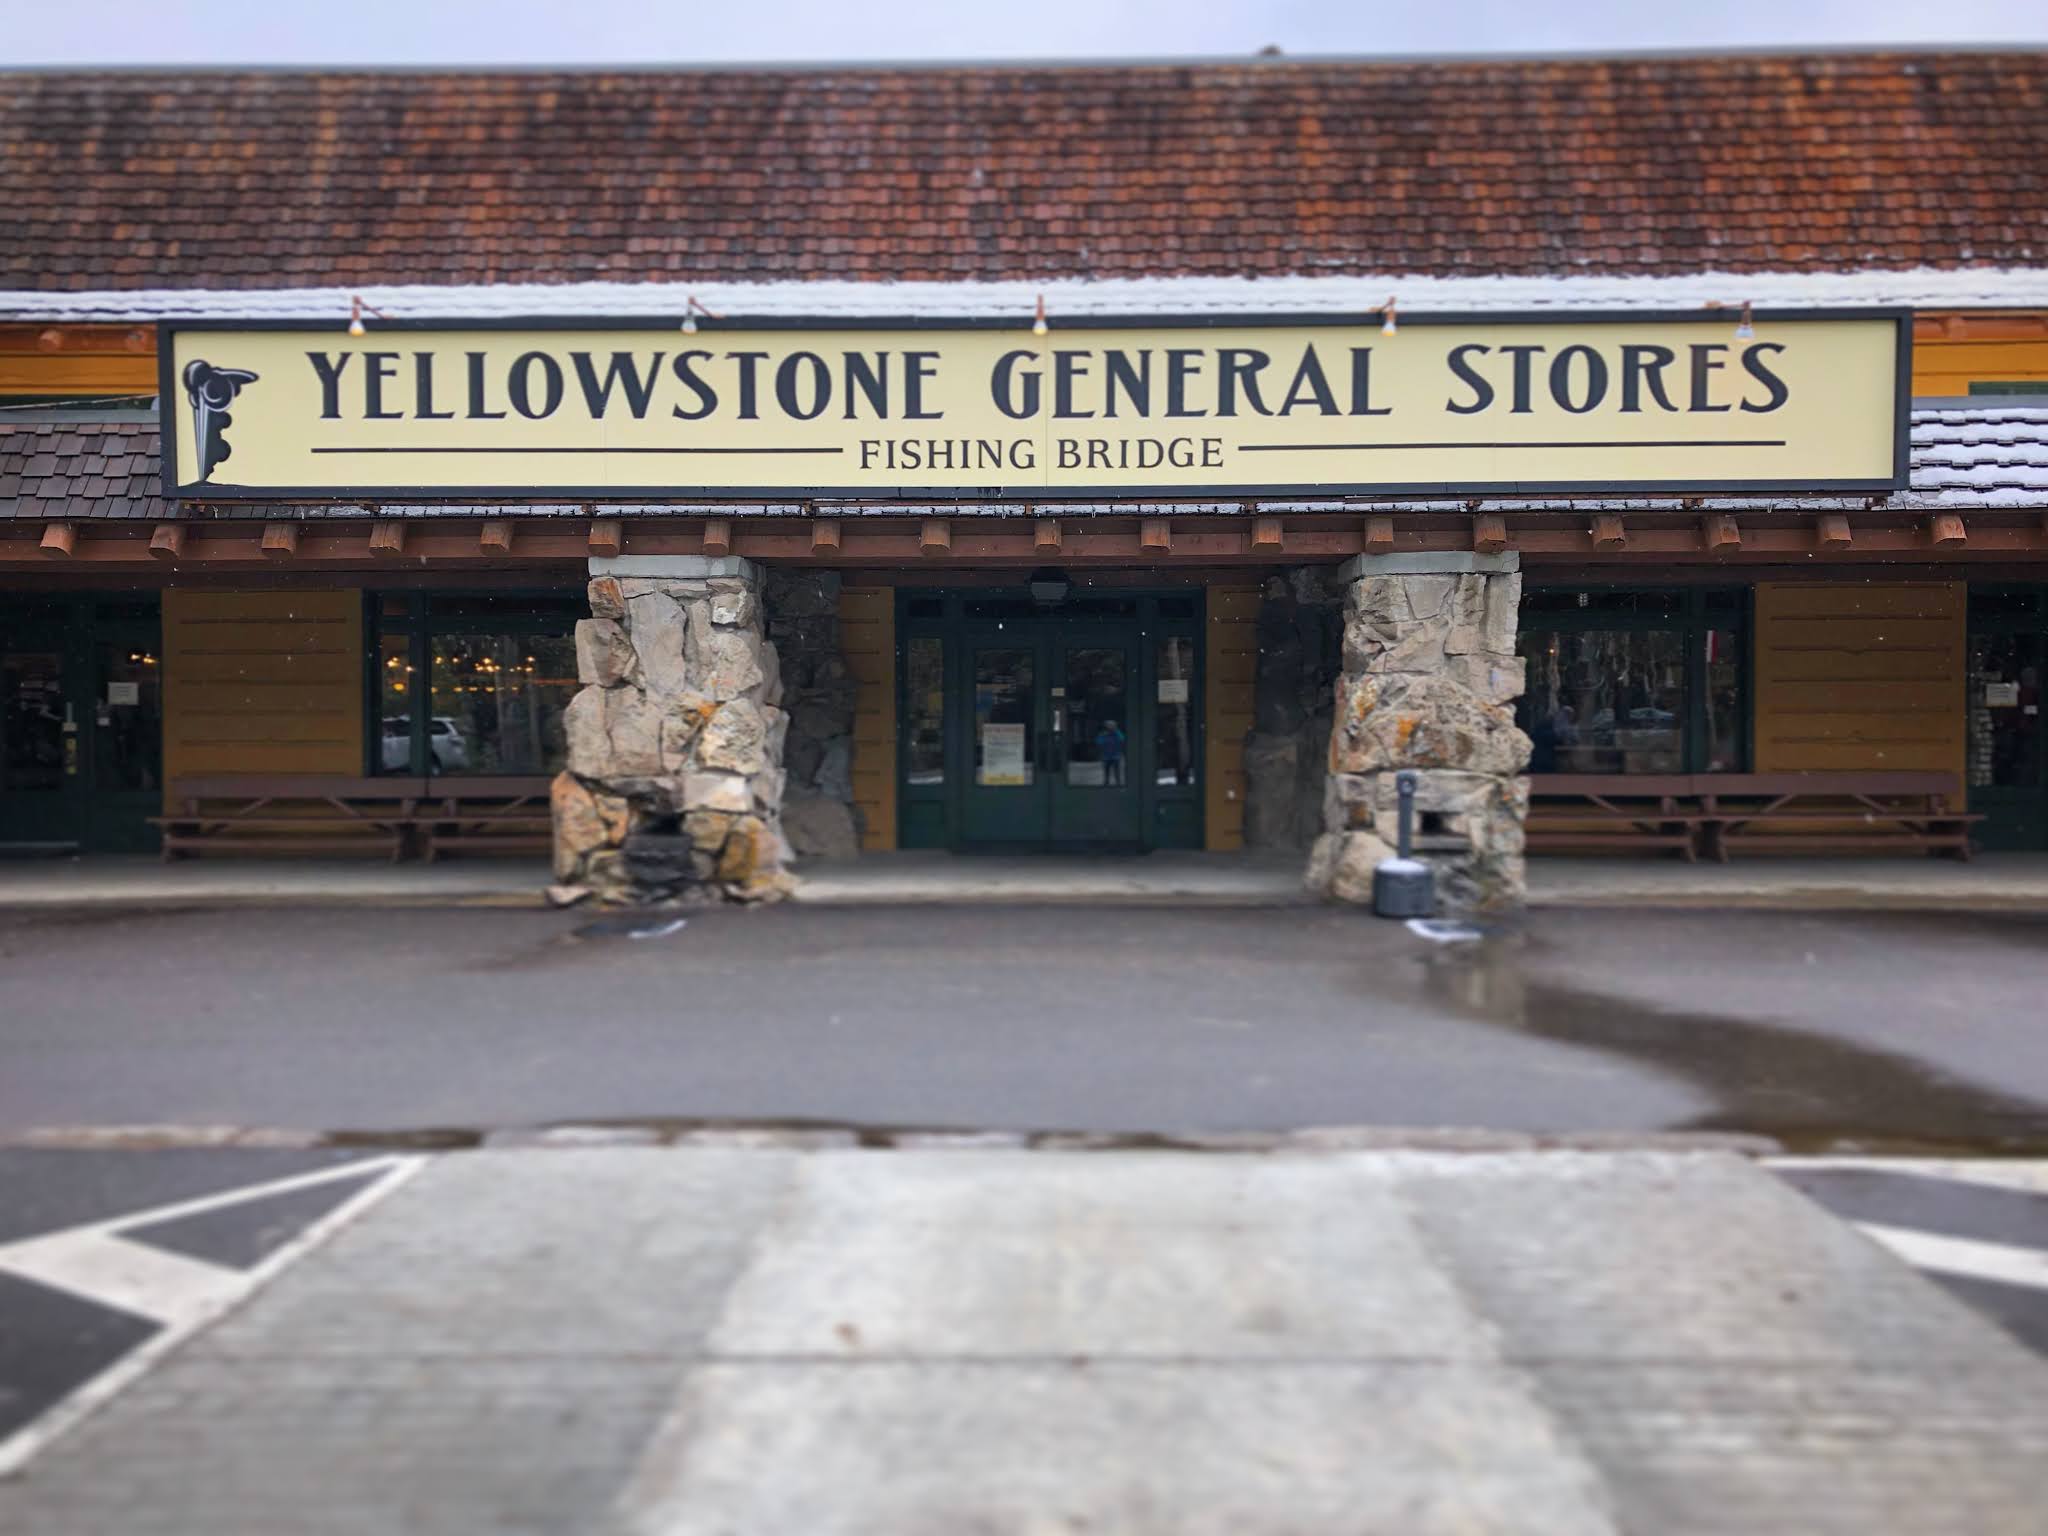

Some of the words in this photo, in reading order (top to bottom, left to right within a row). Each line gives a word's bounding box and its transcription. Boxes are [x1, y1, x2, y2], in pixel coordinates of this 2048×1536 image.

[305, 350, 944, 421] YELLOWSTONE
[990, 344, 1393, 420] GENERAL
[1445, 342, 1789, 416] STORES
[859, 438, 1037, 470] FISHING
[1056, 437, 1225, 470] BRIDGE
